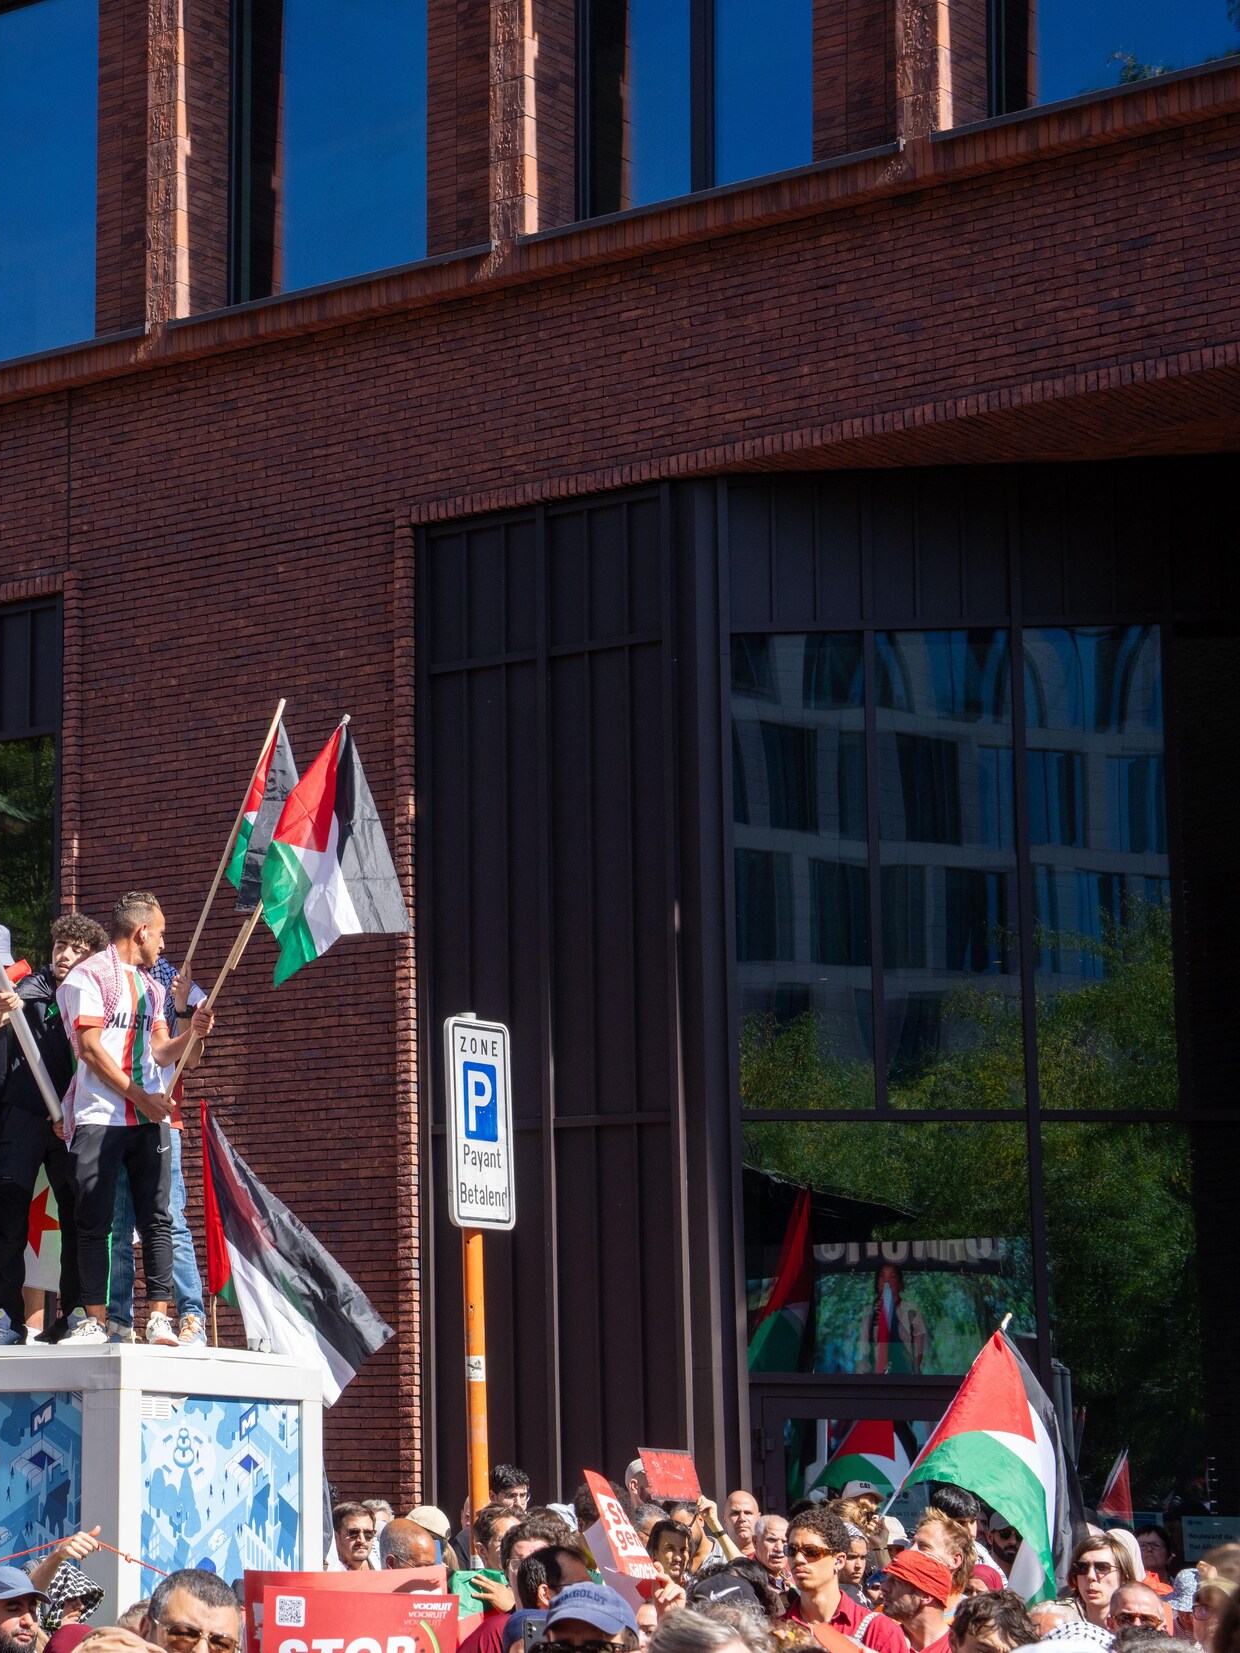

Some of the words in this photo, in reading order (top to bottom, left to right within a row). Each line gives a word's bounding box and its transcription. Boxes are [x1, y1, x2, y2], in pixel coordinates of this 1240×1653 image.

[105, 1012, 153, 1032] PALESTI
[460, 1036, 498, 1057] ZONE
[467, 1069, 492, 1132] P
[463, 1143, 501, 1172] Payant
[460, 1181, 507, 1207] Betalend
[408, 1611, 447, 1619] VOORUIT
[413, 1602, 453, 1611] VOORUIT
